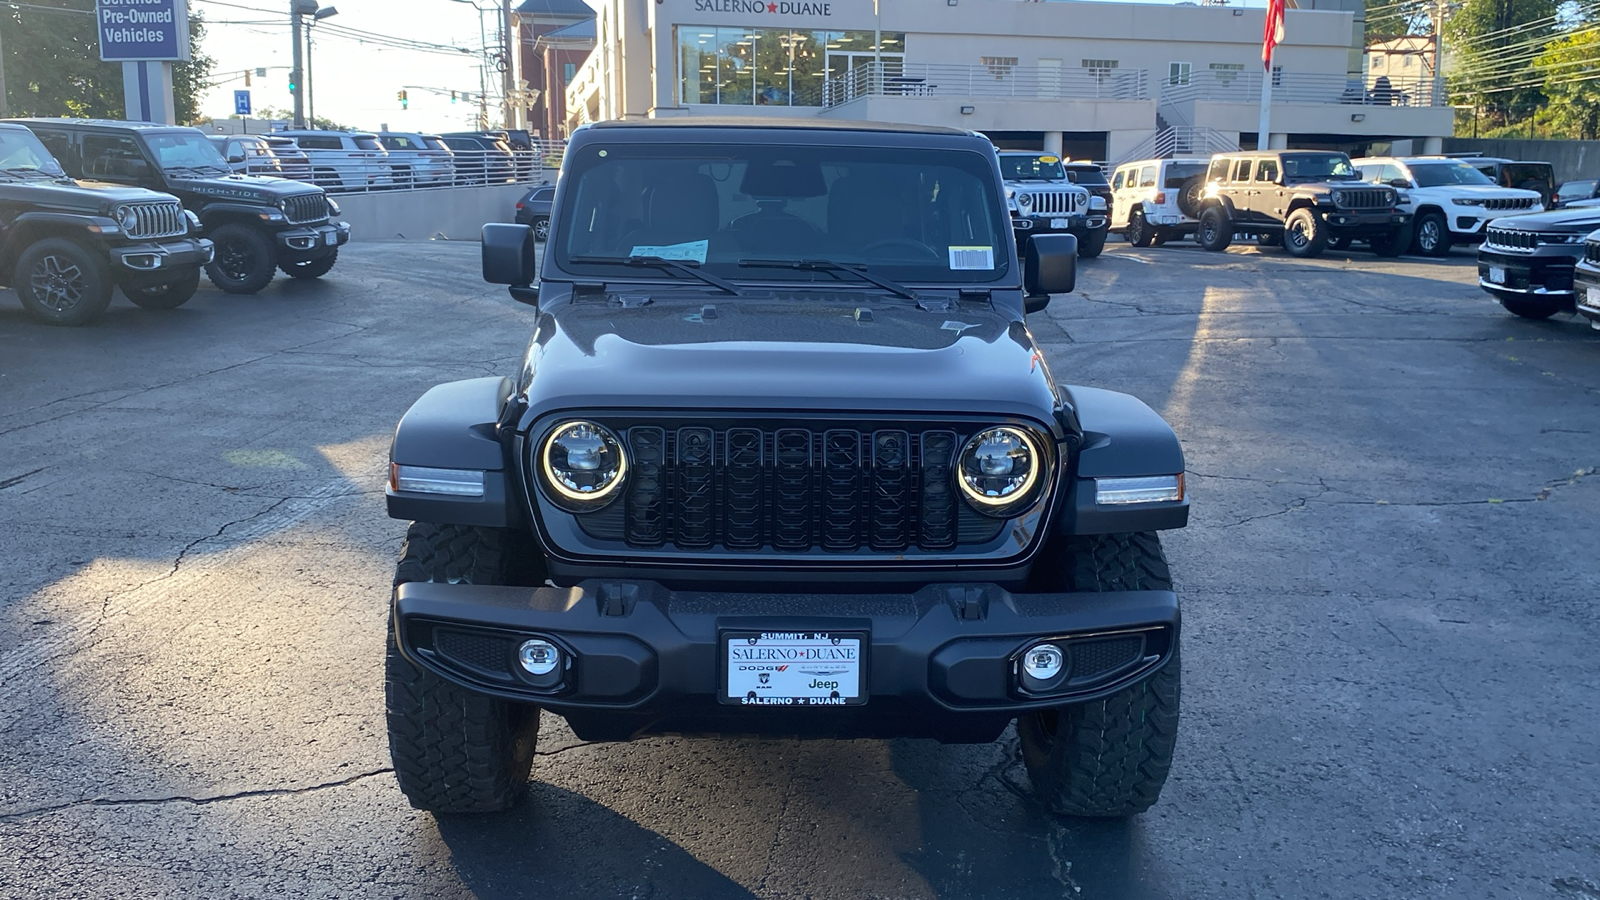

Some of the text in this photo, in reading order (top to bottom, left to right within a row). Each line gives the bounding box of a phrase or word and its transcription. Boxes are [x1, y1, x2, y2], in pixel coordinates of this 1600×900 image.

[695, 0, 832, 16] SALERNO DUANE
[102, 8, 172, 24] Pre-Owned
[104, 27, 164, 43] Vehicles
[237, 95, 248, 108] H
[732, 648, 856, 660] SALERNO DUANE
[808, 678, 839, 690] Jeep
[741, 697, 847, 705] SALERNO DUANE
